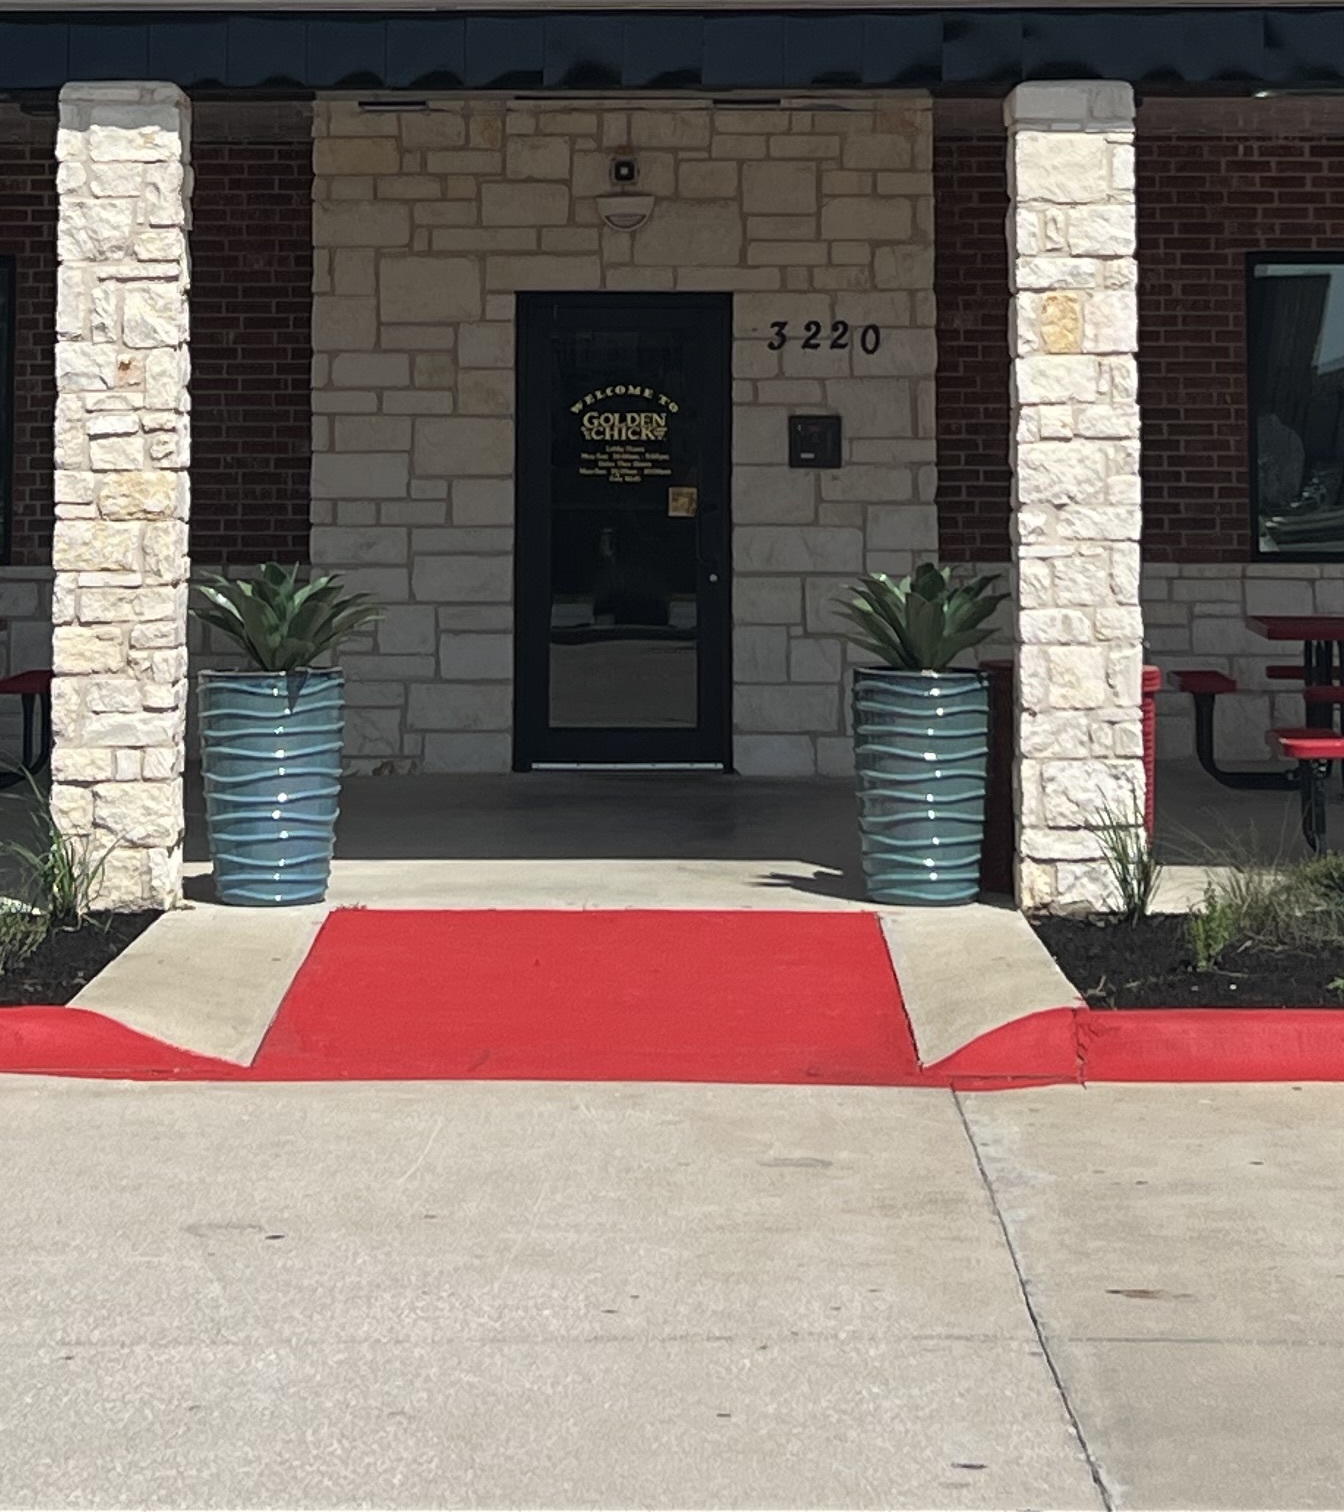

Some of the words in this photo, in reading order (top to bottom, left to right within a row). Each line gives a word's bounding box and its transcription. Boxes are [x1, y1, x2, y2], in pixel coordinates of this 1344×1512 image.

[767, 320, 881, 355] 3220
[569, 384, 654, 414] WELCOME
[658, 393, 679, 413] TO
[582, 411, 667, 429] GOLDEN
[590, 425, 656, 441] CHICK
